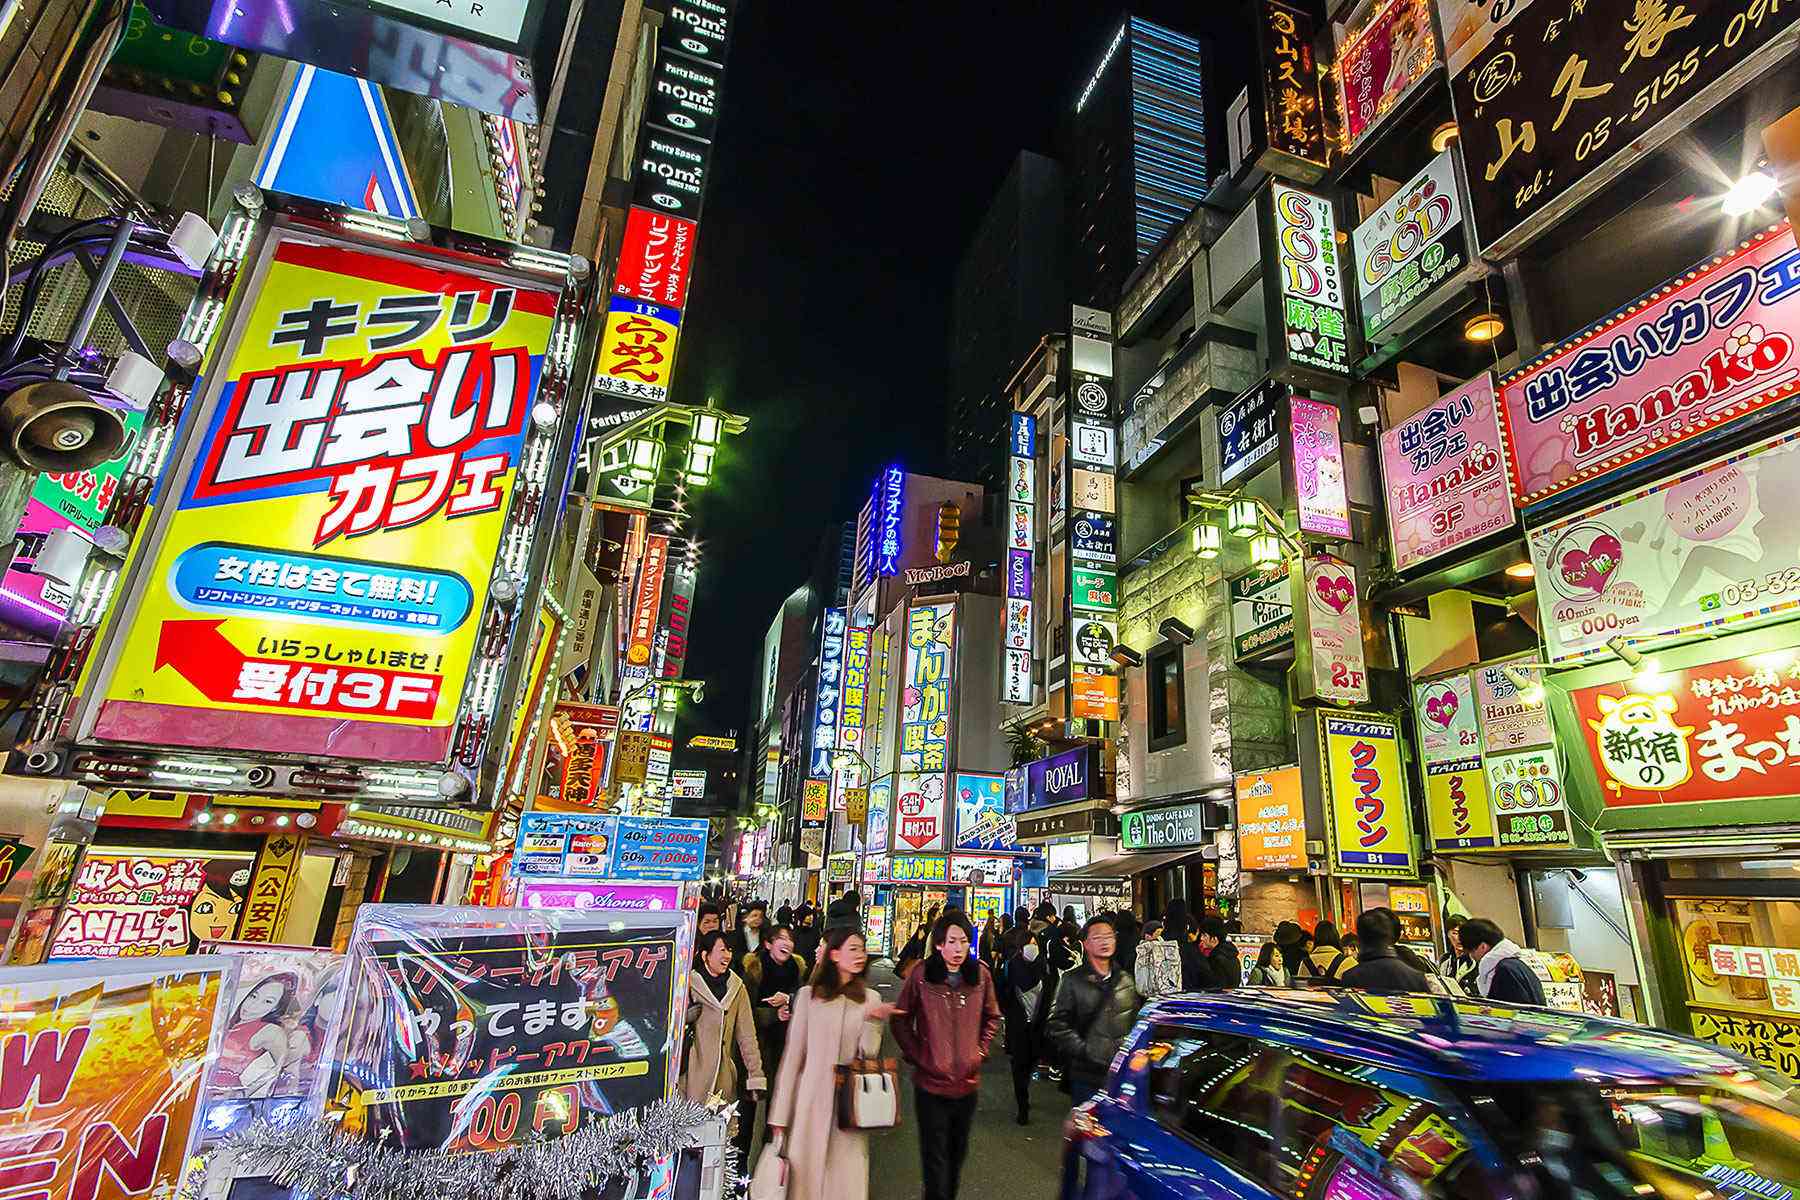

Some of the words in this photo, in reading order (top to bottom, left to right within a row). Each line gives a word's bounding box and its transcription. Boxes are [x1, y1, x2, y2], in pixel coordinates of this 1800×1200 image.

[665, 63, 688, 80] Party
[651, 139, 674, 157] Party
[1277, 190, 1323, 298] GOD
[1364, 194, 1453, 286] GOD
[270, 288, 518, 360] キラリ
[635, 302, 661, 317] 1F
[1286, 299, 1346, 341] 麻雀
[608, 315, 670, 384] らーめん
[1314, 337, 1346, 363] 4F
[597, 376, 667, 401] 博多天神
[1570, 328, 1795, 459] Hanako
[205, 347, 520, 486] 出会い
[590, 413, 622, 429] Party
[1398, 394, 1474, 457] 出会い
[1409, 431, 1469, 476] カフェ
[1397, 447, 1502, 516] Hanako
[312, 453, 512, 549] カフェ
[881, 466, 903, 573] カラオケの鉄人
[1430, 501, 1466, 537] 3F
[1013, 556, 1025, 592] ROYAL
[1556, 605, 1596, 623] 40min
[231, 661, 435, 712] 受付3F
[812, 611, 845, 776] カラオケの鉄人
[904, 606, 950, 771] まんが喫茶
[1330, 661, 1364, 690] 2F
[1508, 731, 1527, 745] 3F
[1603, 725, 1681, 765] 新宿
[1045, 761, 1084, 794] ROYAL
[1349, 739, 1389, 849] クラウン
[1495, 777, 1560, 811] GOD
[1638, 765, 1665, 786] の
[1448, 775, 1472, 836] クラウン
[532, 838, 558, 847] VISA
[1147, 825, 1165, 844] The
[1165, 818, 1195, 843] Olive
[1458, 838, 1471, 847] B1
[1366, 852, 1384, 864] B1
[590, 891, 648, 911] Aroma
[58, 908, 189, 946] ANILLA
